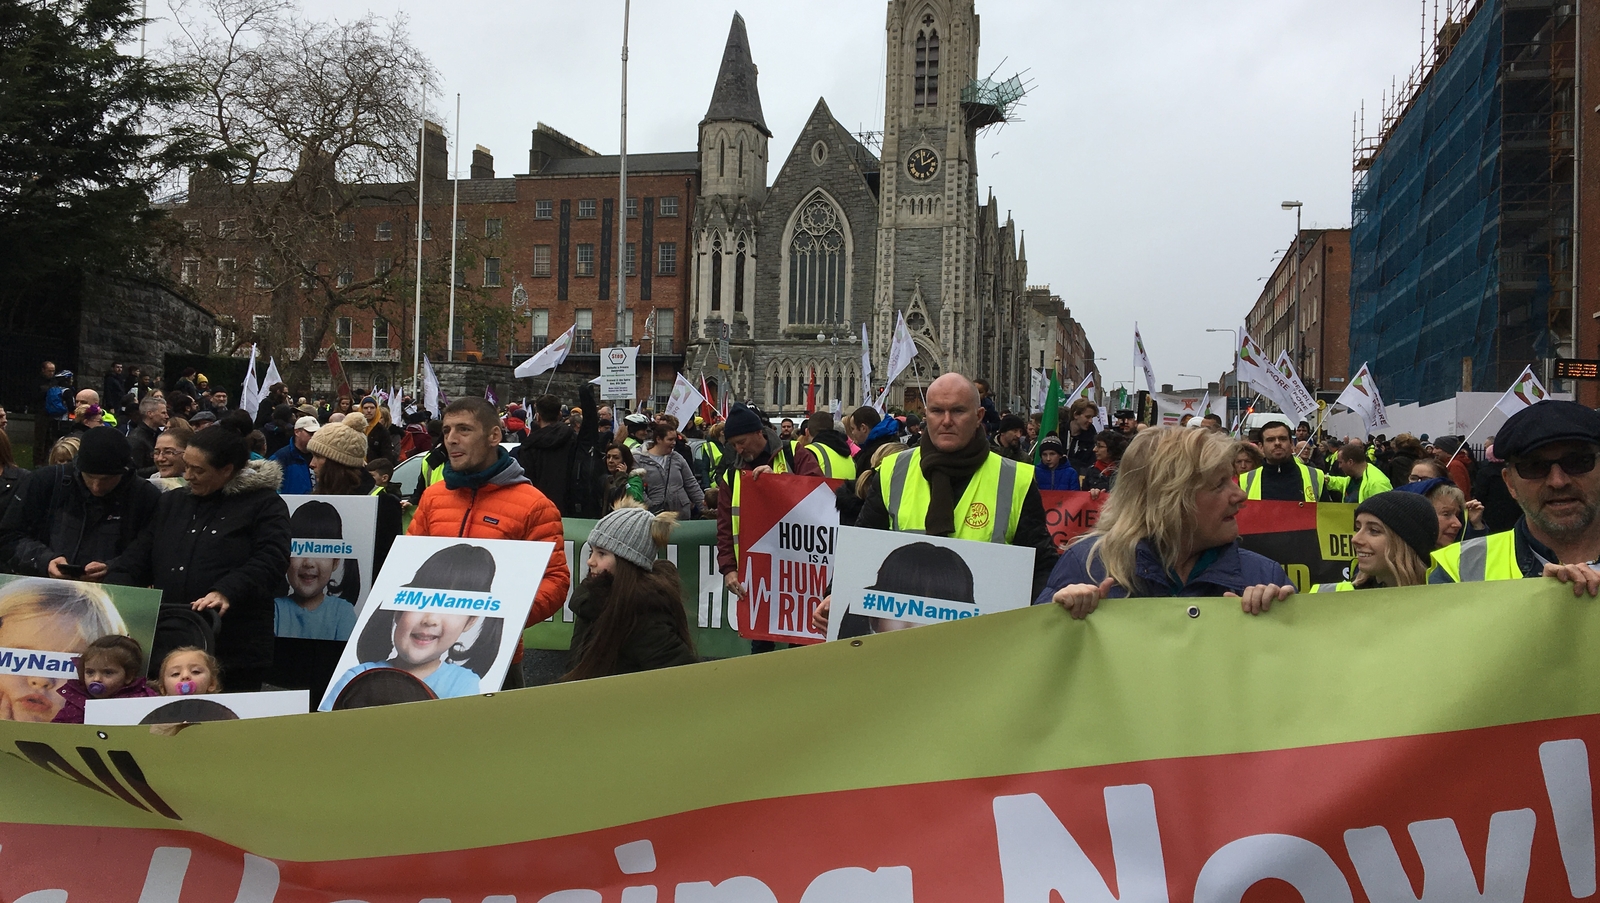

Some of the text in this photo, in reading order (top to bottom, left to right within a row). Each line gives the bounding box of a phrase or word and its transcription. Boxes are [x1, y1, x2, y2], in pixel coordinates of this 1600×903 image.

[779, 522, 838, 555] HOUSI
[808, 553, 829, 565] IS A
[779, 560, 834, 596] HUM
[393, 590, 501, 611] #MyNameis
[863, 593, 983, 620] #MyNamei
[993, 739, 1597, 903] Now!
